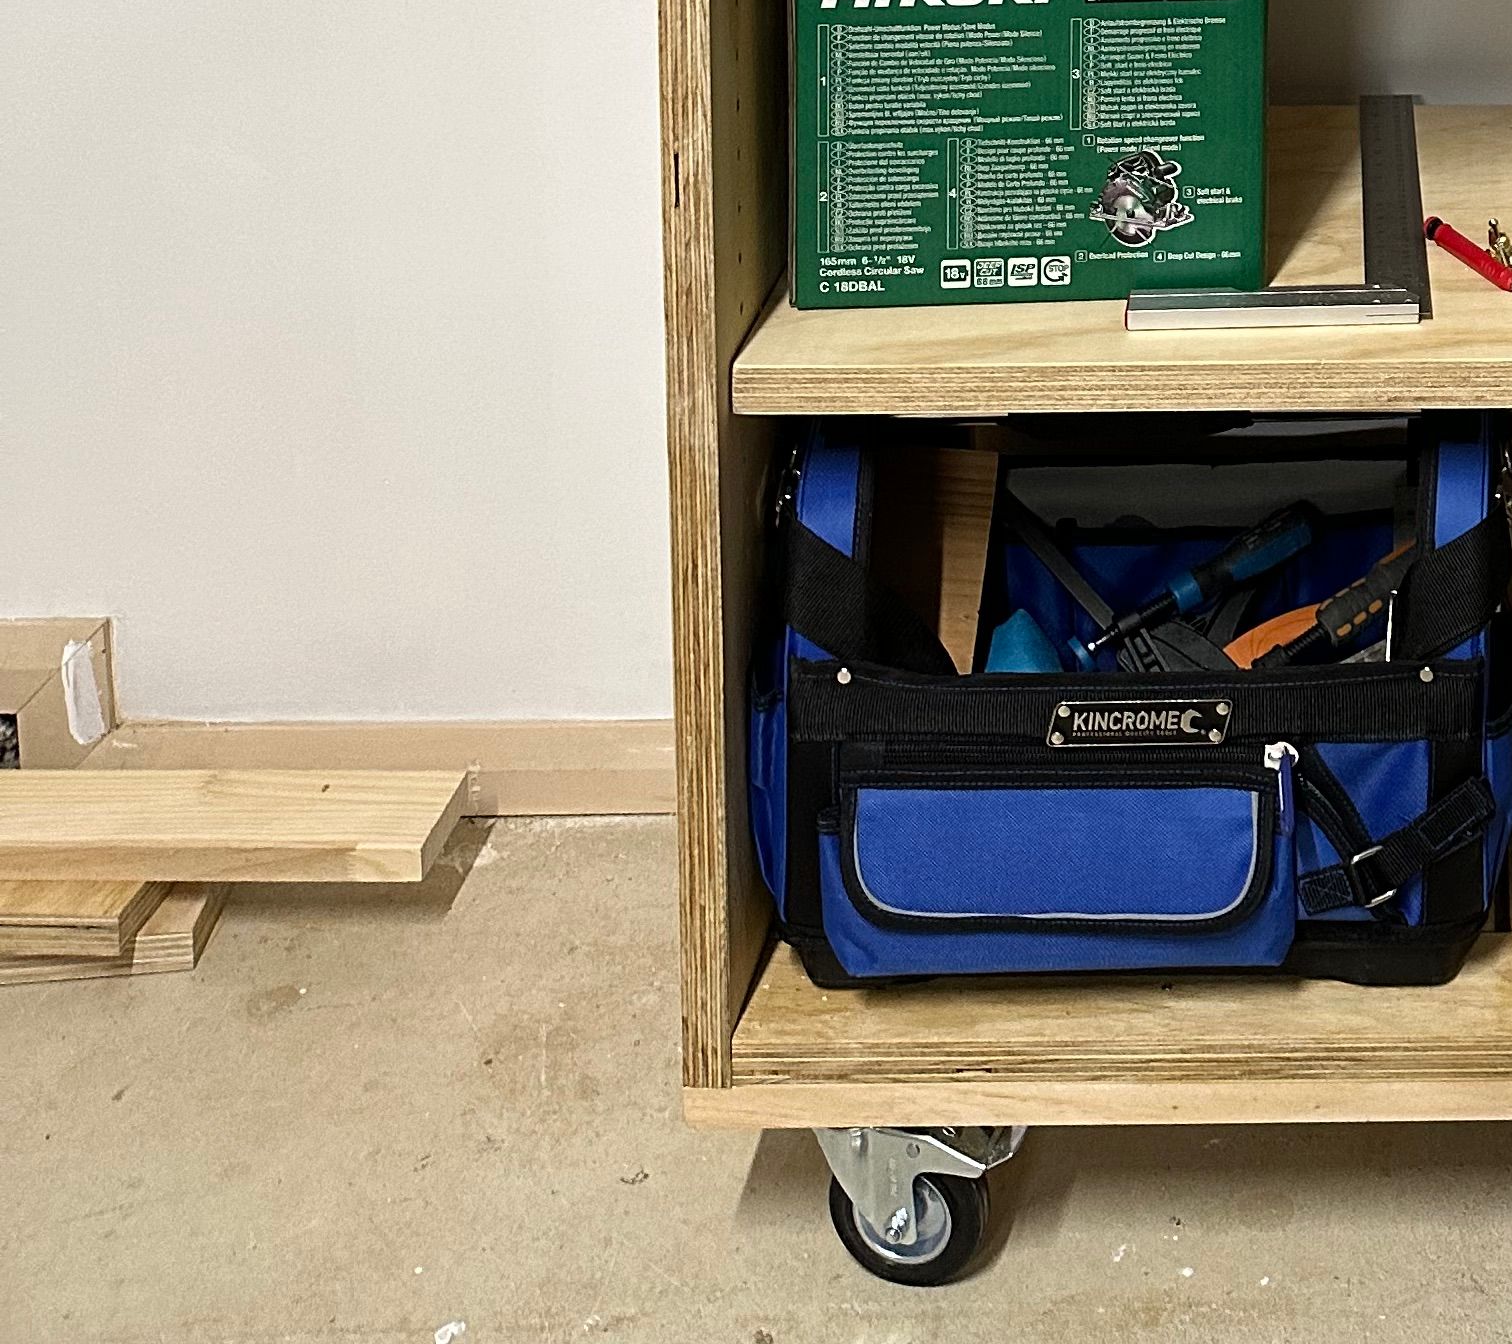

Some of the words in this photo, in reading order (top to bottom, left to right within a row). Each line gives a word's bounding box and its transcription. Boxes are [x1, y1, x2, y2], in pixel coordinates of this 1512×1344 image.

[1072, 68, 1080, 79] 3
[820, 76, 827, 86] 1
[819, 191, 828, 202] 2
[948, 189, 958, 198] 4
[896, 255, 916, 265] 18V
[819, 267, 862, 277] Cordless
[863, 266, 901, 276] Circular
[903, 265, 925, 275] Saw
[1048, 263, 1069, 273] STOP
[819, 281, 831, 293] C
[1072, 710, 1180, 731] KINCROME
